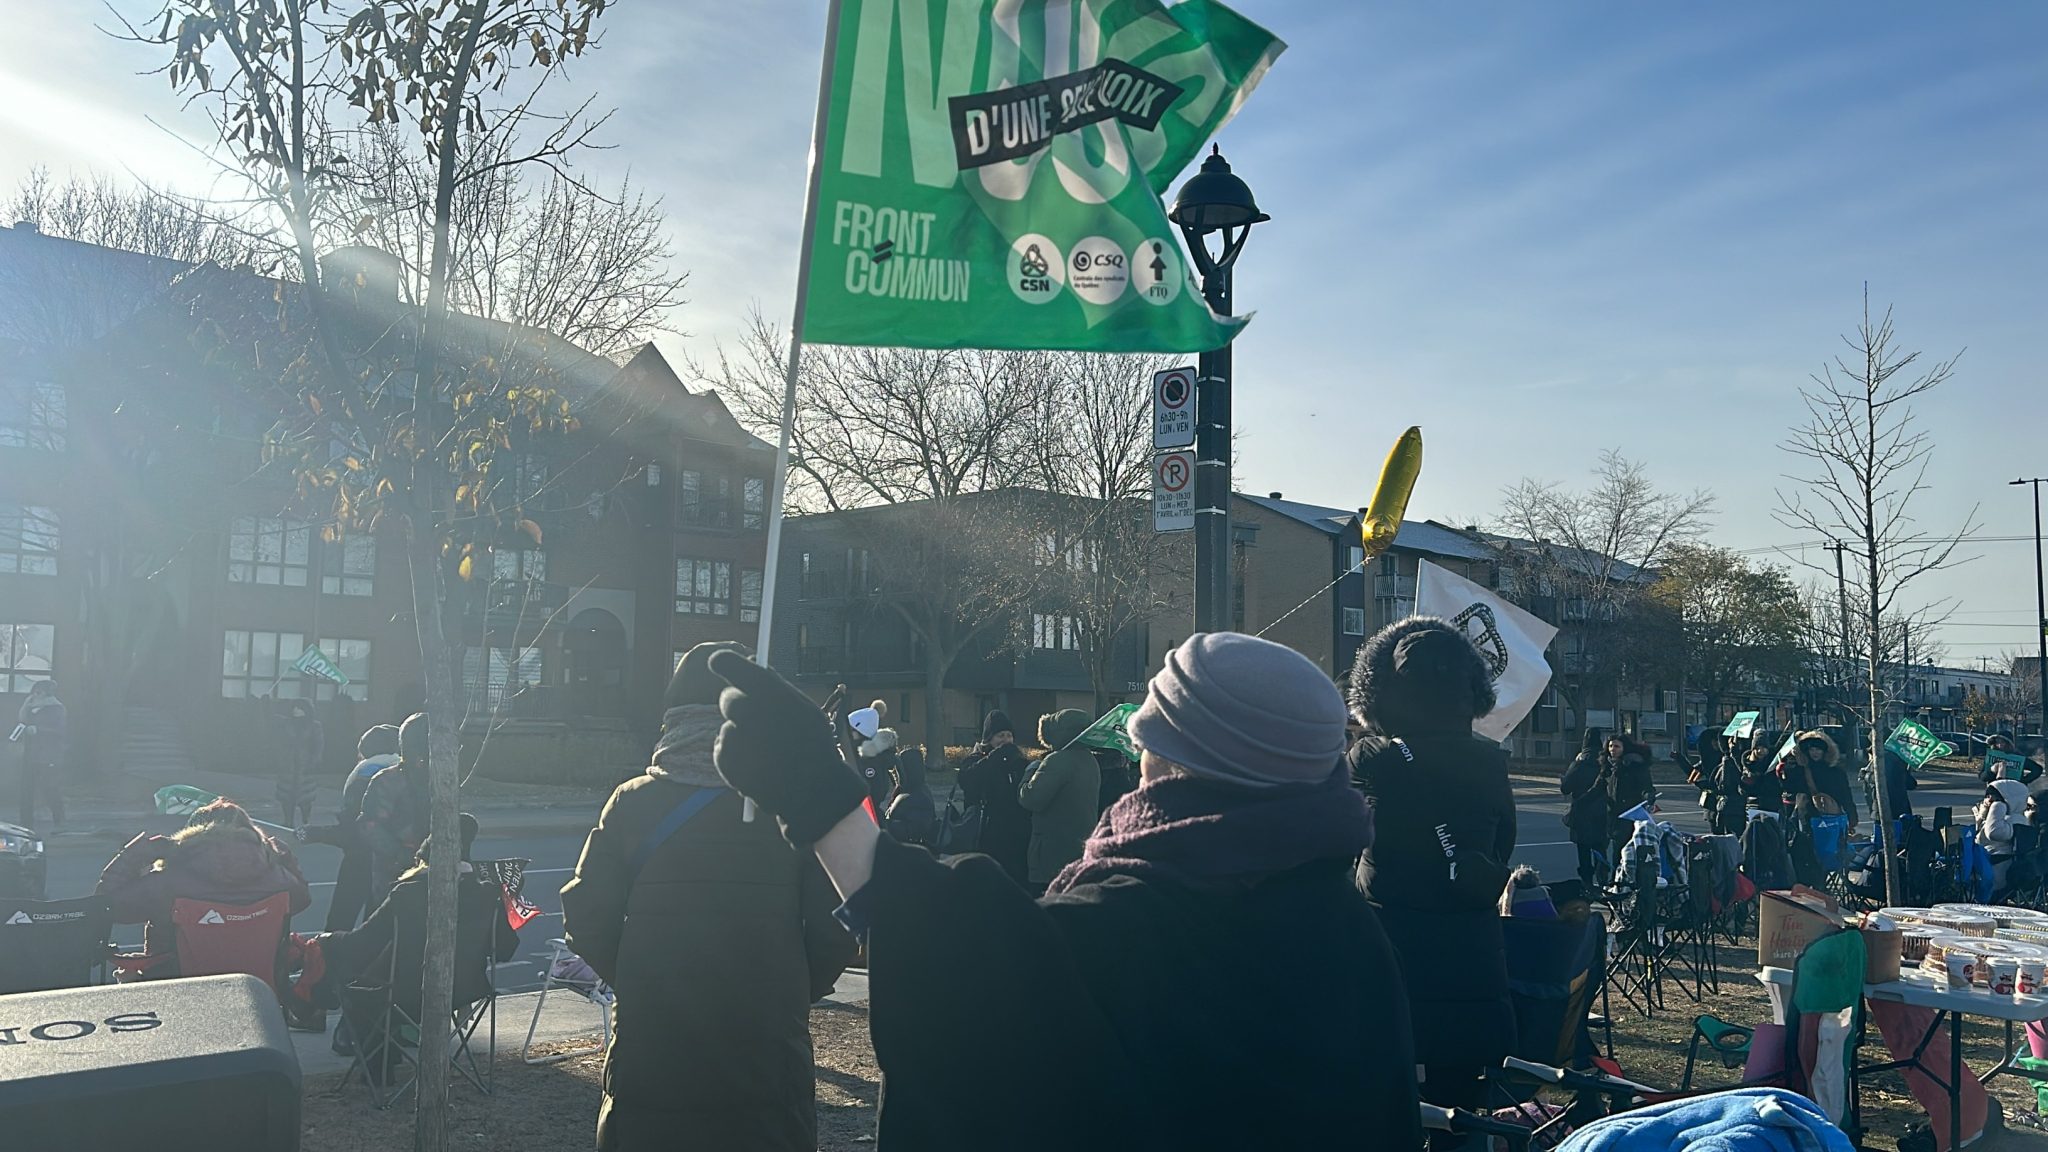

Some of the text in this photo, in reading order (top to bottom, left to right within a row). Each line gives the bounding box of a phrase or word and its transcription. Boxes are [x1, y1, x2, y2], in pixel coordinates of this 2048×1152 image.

[966, 94, 1052, 156] D'UNE
[833, 200, 936, 256] FRONT
[1094, 254, 1123, 269] CSQ
[845, 249, 970, 303] COMMUN
[1020, 279, 1050, 292] CSN
[1150, 286, 1168, 298] FTQ
[1127, 681, 1145, 692] 7510
